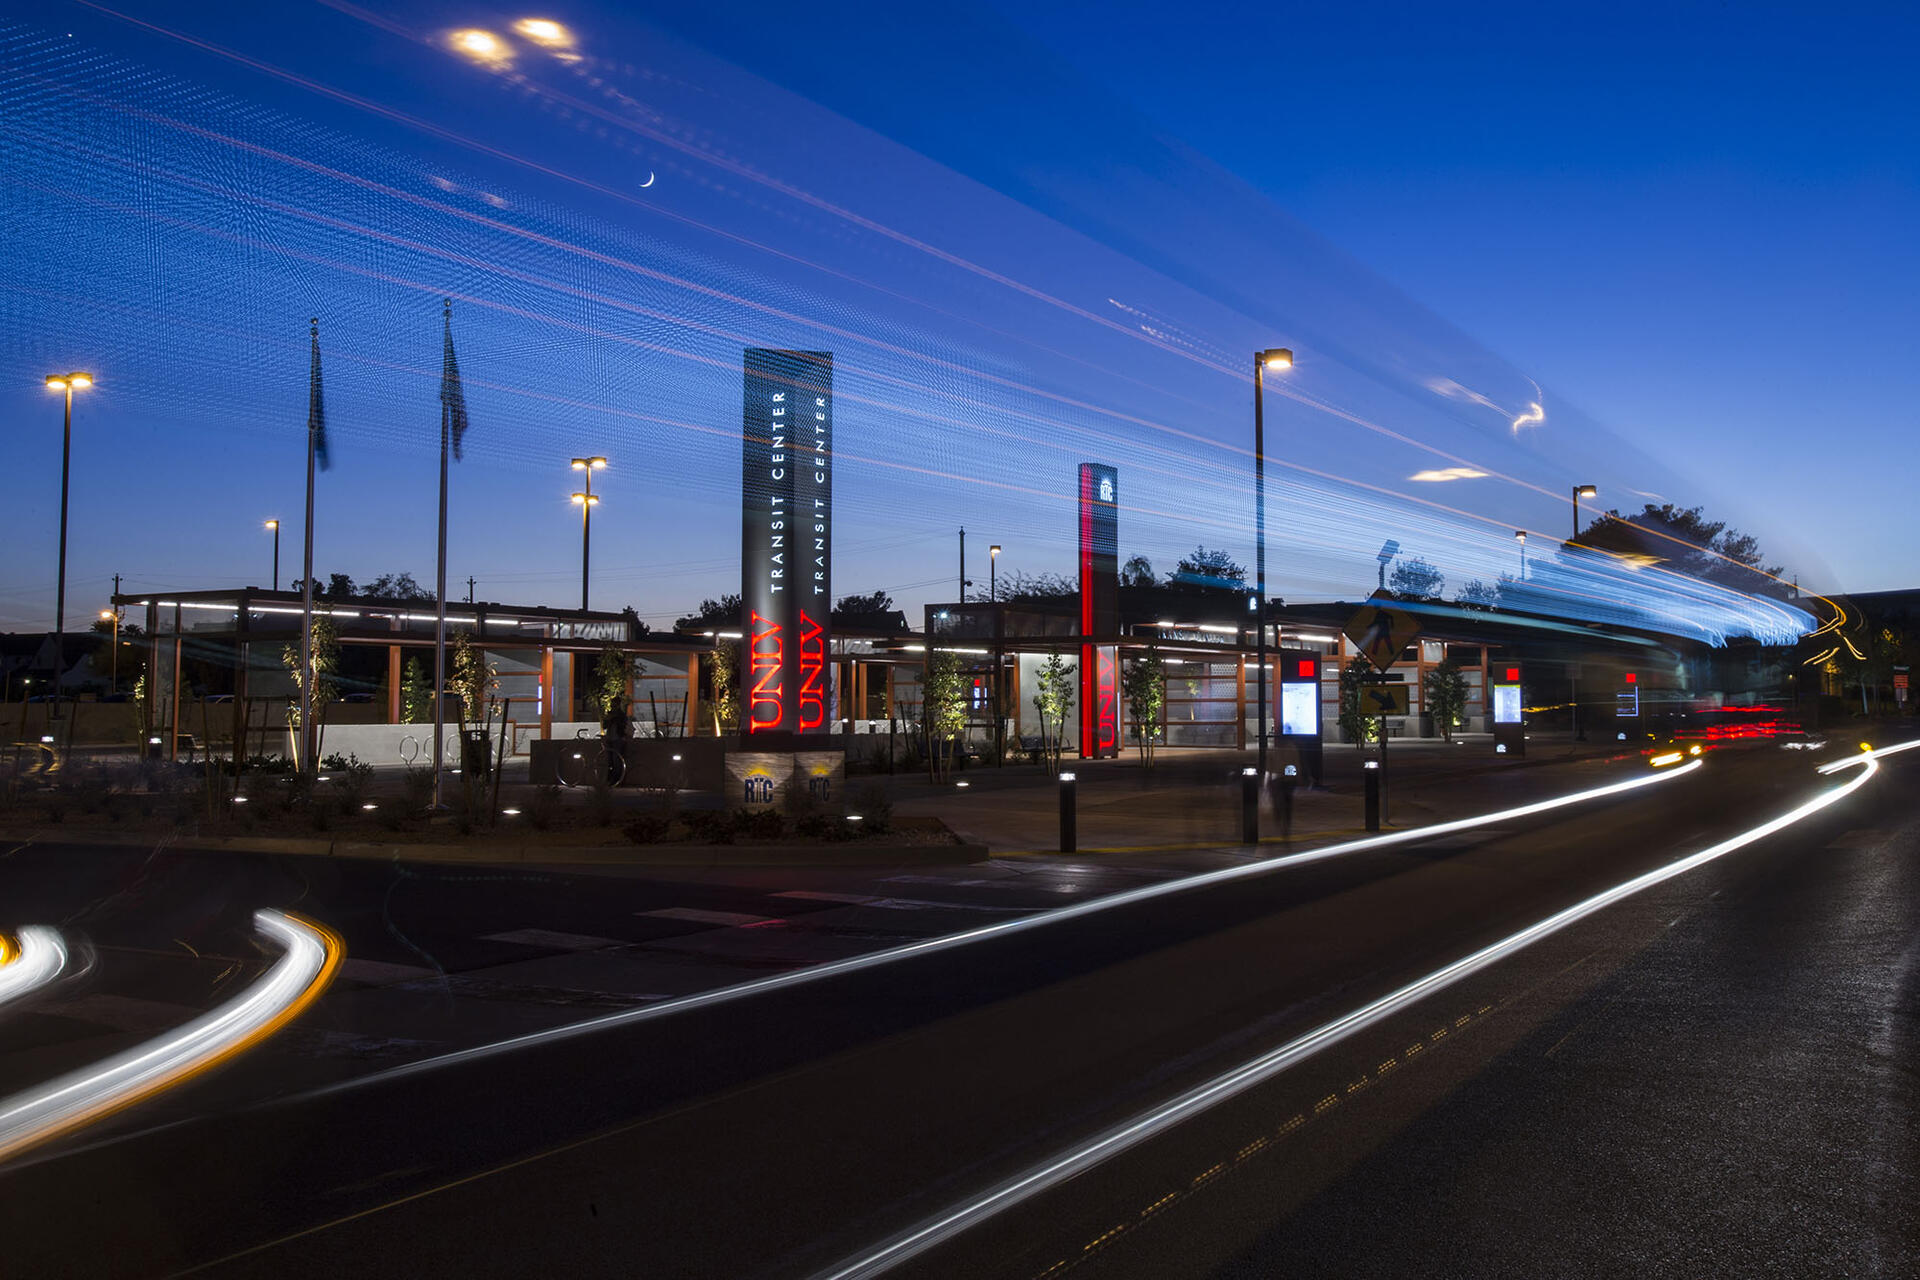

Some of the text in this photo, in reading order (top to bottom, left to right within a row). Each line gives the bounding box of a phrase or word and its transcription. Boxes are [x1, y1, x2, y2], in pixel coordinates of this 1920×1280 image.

[771, 392, 785, 594] TRANSIT CENTER
[815, 397, 825, 594] TRANSIT CENTER
[750, 609, 783, 734] UNLV
[800, 609, 824, 734] UNLV
[1099, 650, 1115, 750] UNLV
[744, 777, 774, 803] RTC
